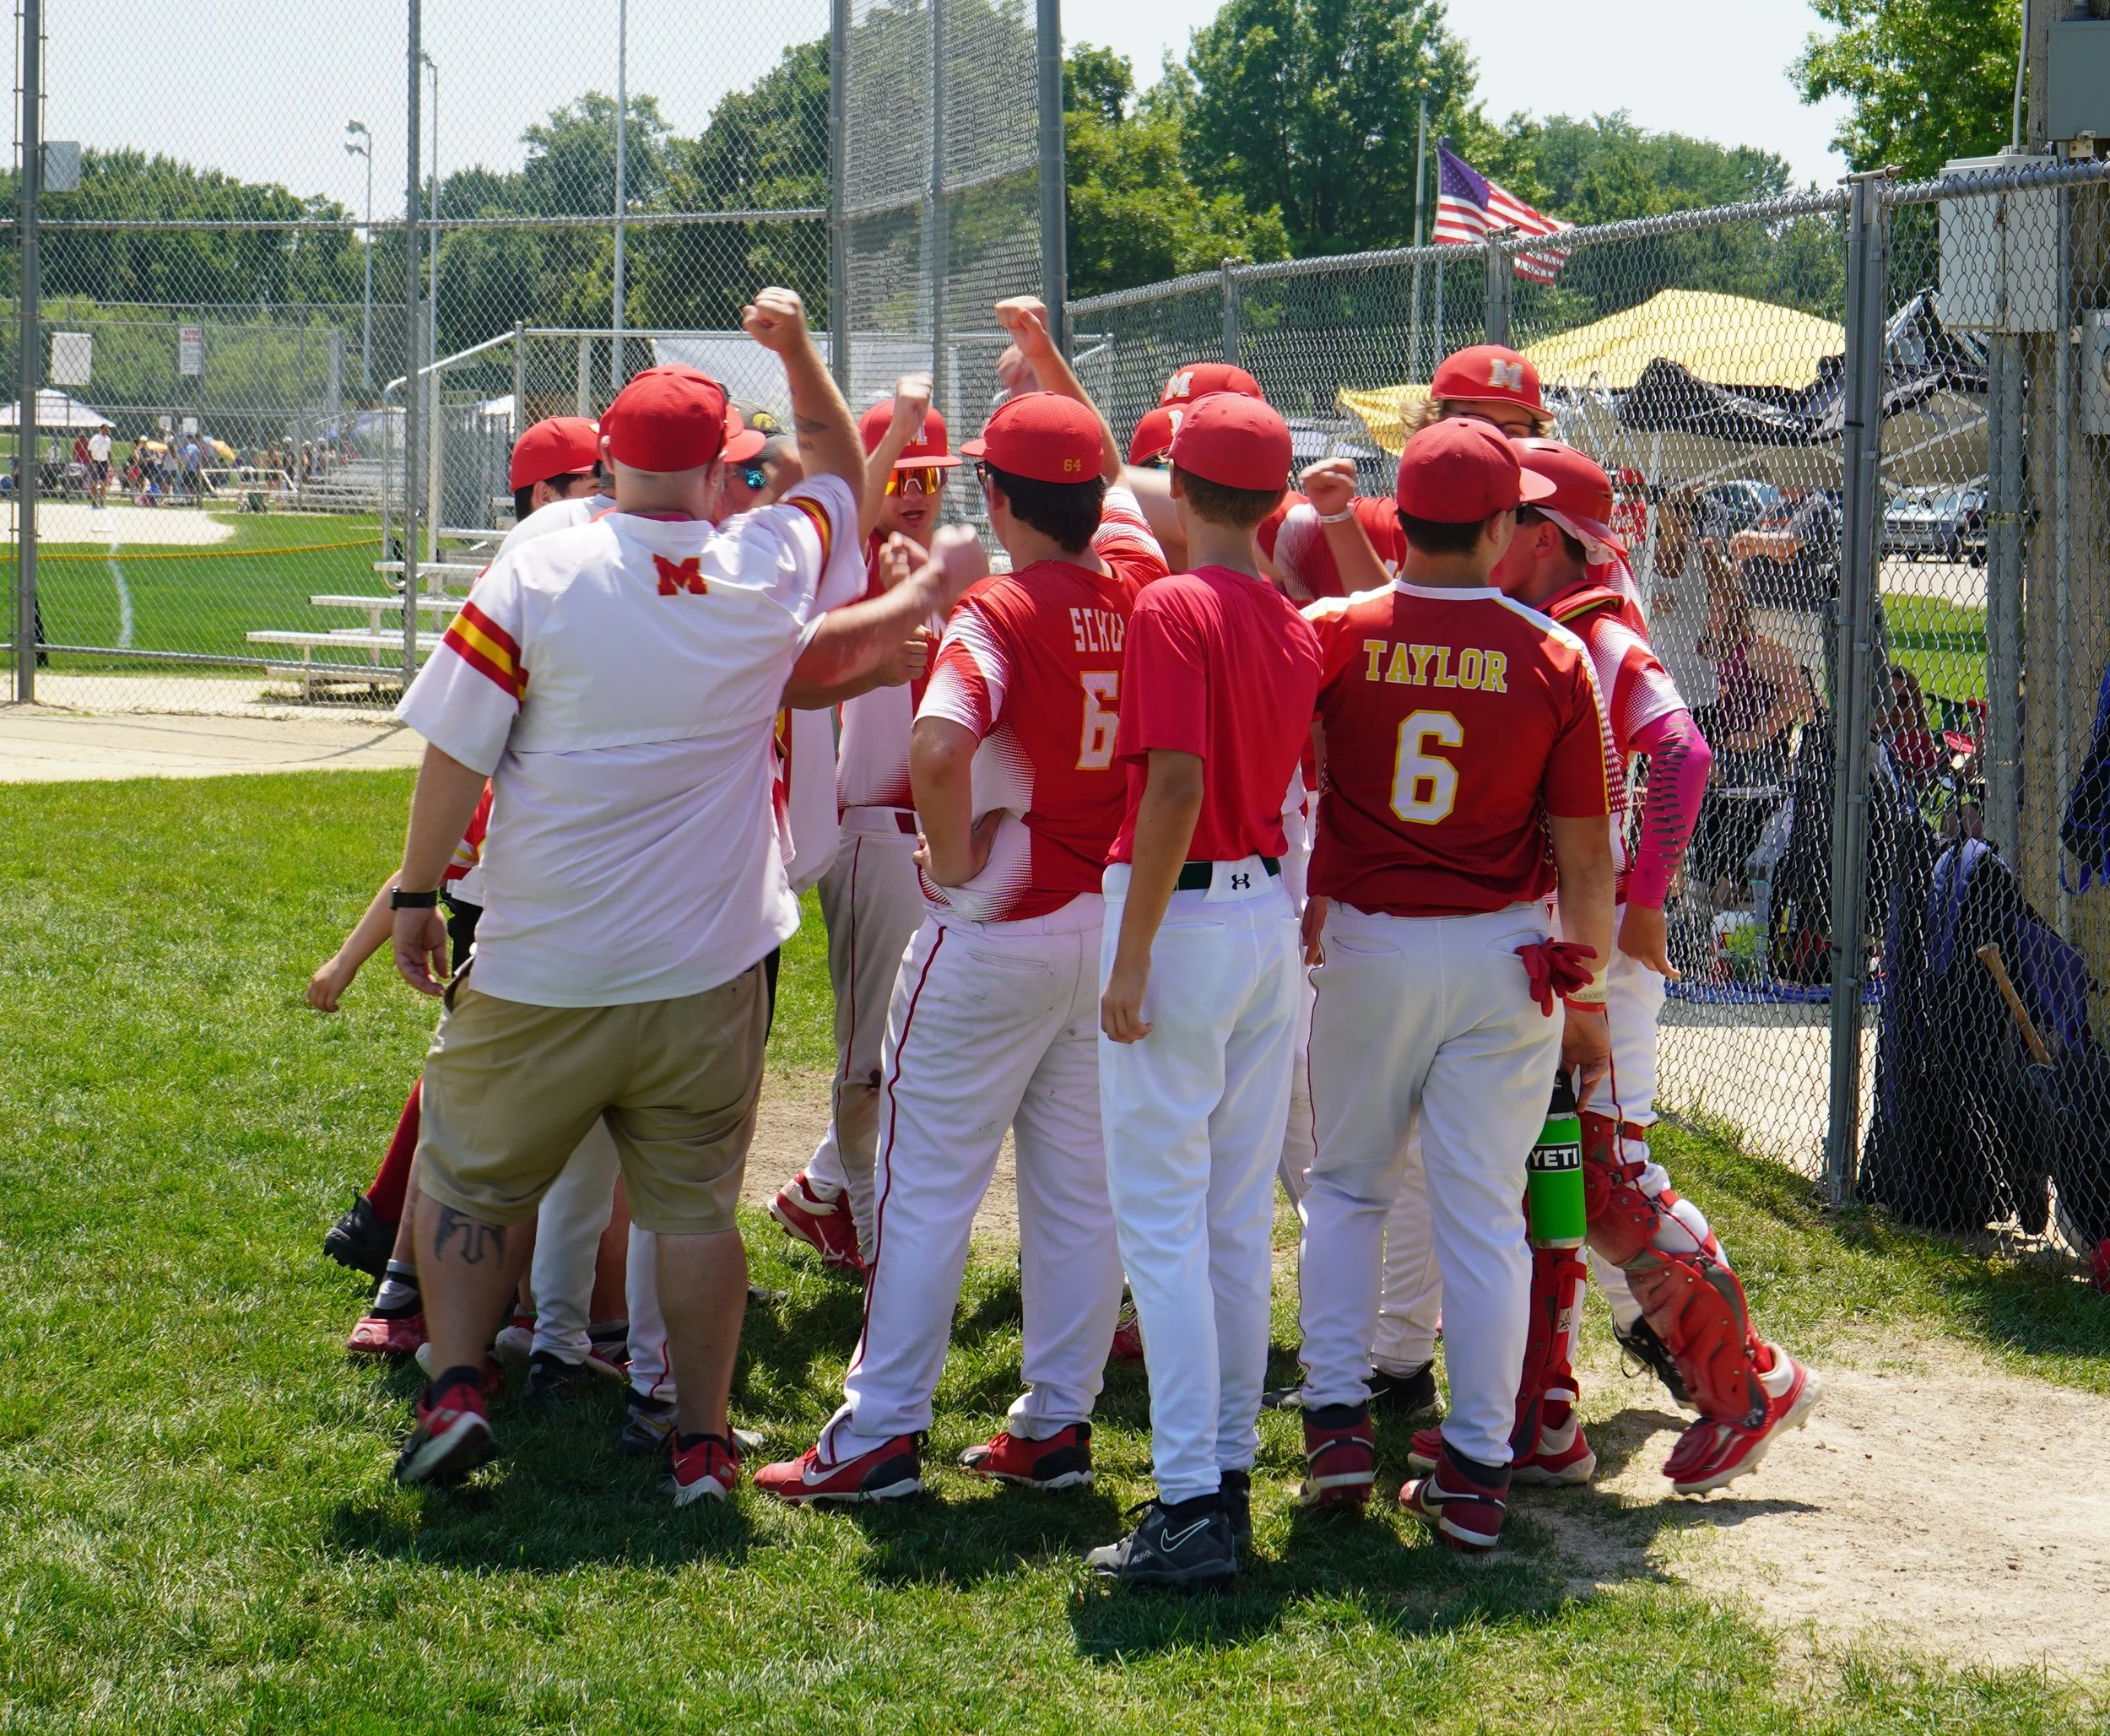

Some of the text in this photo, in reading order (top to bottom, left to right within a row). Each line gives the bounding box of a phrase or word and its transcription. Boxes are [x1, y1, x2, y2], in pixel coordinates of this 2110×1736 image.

[1165, 371, 1194, 401] M
[1488, 358, 1523, 393] M
[1063, 458, 1082, 472] 64
[652, 553, 708, 596] M
[1363, 639, 1507, 693] TAYLOR
[1074, 670, 1121, 770] 6
[1389, 709, 1464, 825] 6
[1531, 1148, 1577, 1166] YETI
